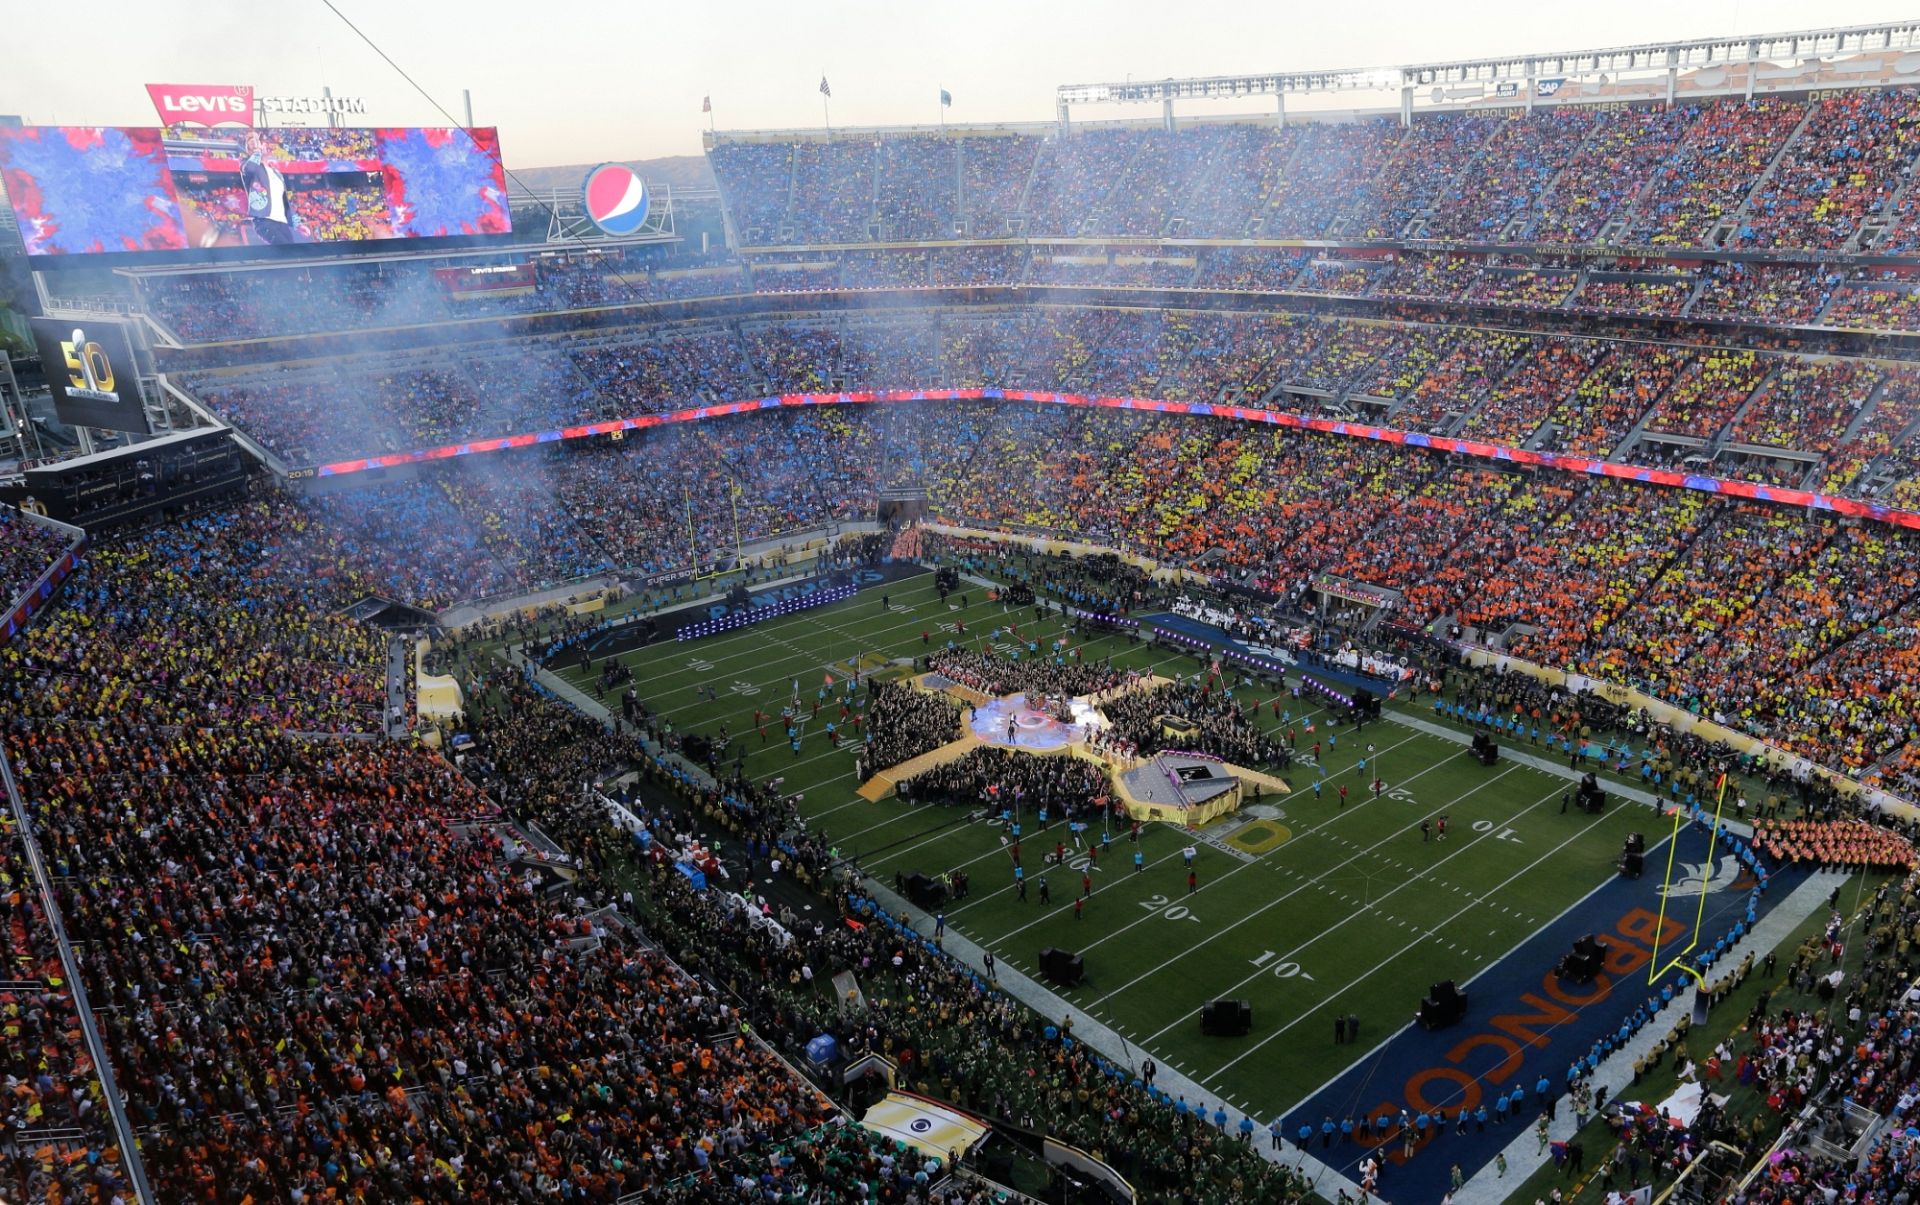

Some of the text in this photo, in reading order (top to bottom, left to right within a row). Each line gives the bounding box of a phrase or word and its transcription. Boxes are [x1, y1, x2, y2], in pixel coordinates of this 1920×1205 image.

[1538, 82, 1559, 95] SAP
[262, 96, 369, 114] STADIUM
[1535, 247, 1666, 258] NATIONAL FOOTBALL LEAGUE
[60, 341, 115, 392] 50
[647, 574, 677, 586] SUPER
[679, 568, 703, 578] BOWL
[1471, 820, 1517, 840] 10
[1209, 840, 1243, 858] BOWL
[1139, 894, 1189, 920] 20
[1248, 949, 1301, 978] 10
[1352, 907, 1688, 1167] BRONCOS
